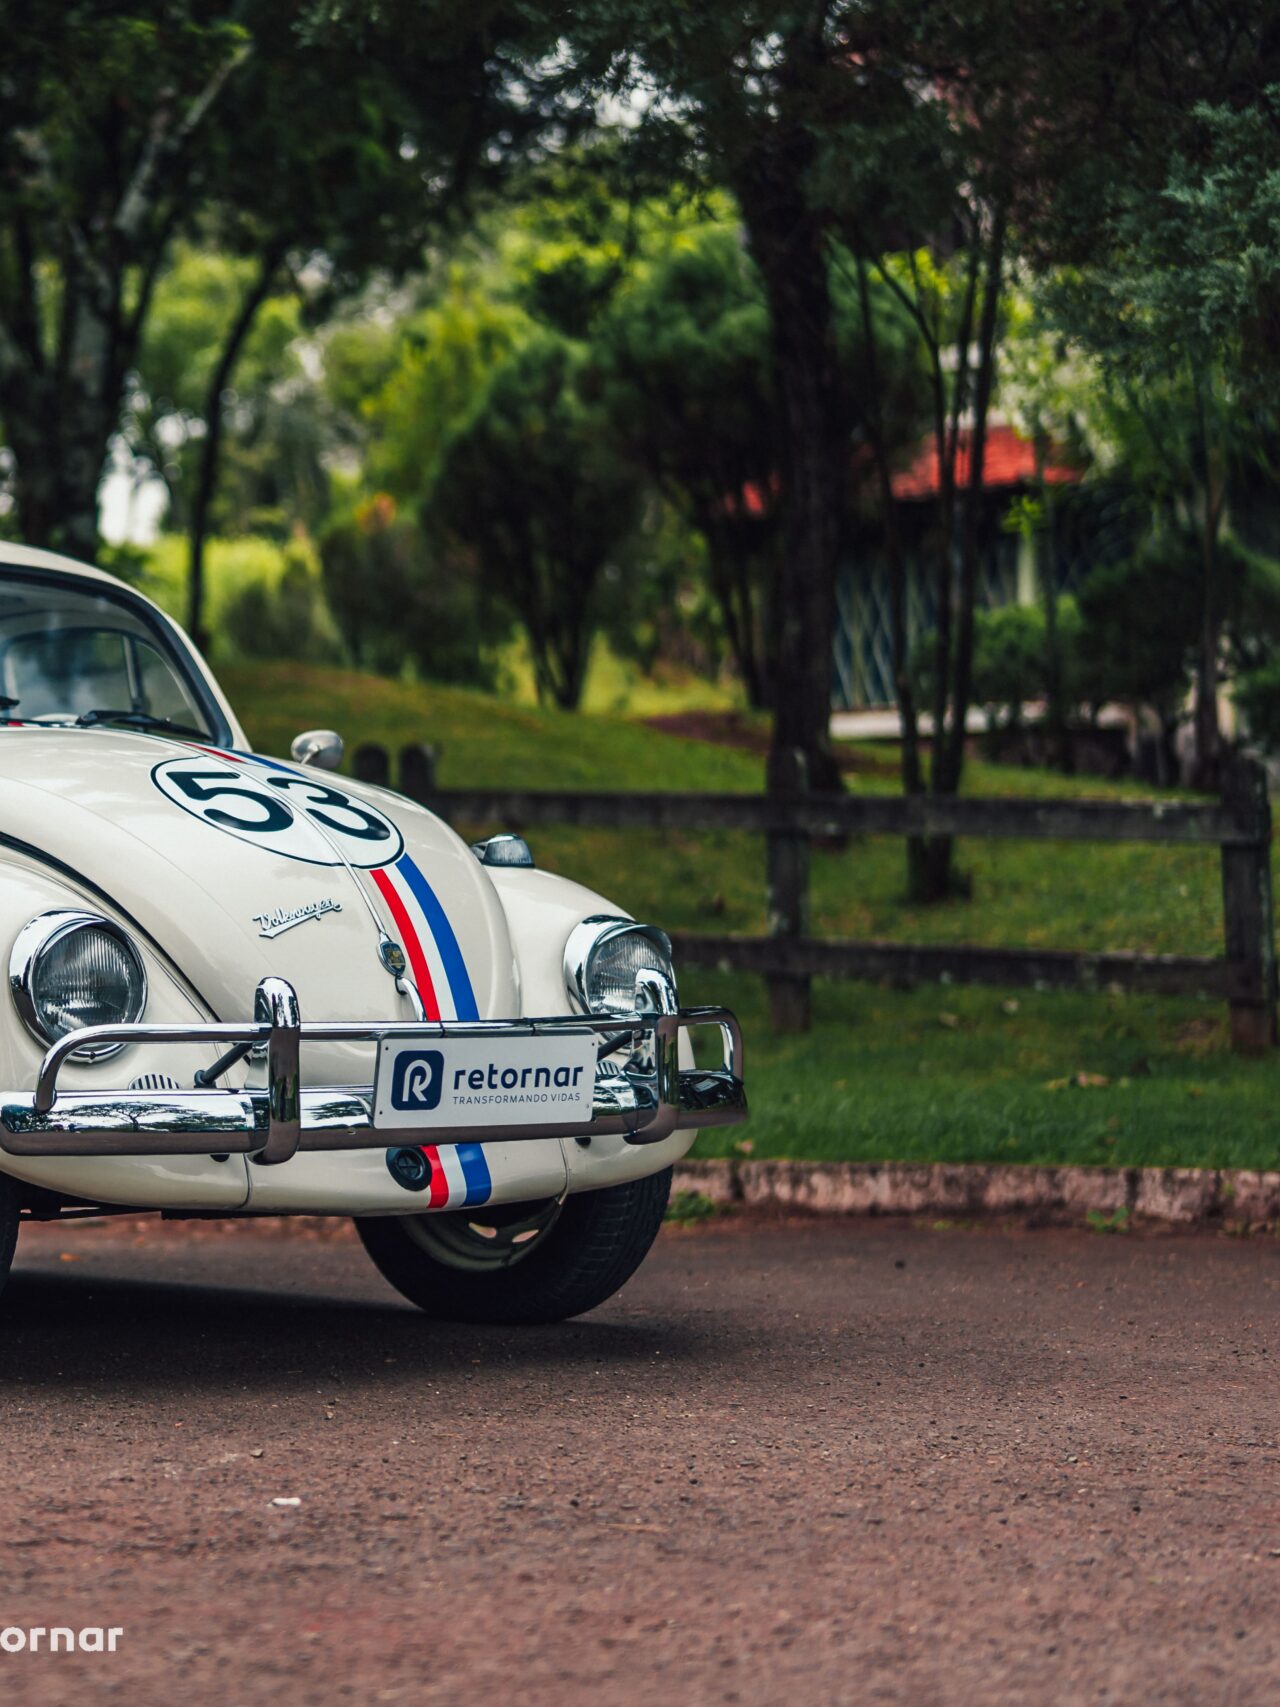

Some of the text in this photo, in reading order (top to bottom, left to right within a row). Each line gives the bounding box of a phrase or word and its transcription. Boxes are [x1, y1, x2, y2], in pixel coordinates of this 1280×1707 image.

[166, 771, 391, 841] 53
[453, 1063, 584, 1090] retornar
[452, 1092, 581, 1105] TRANSFORMANDO VIDAS
